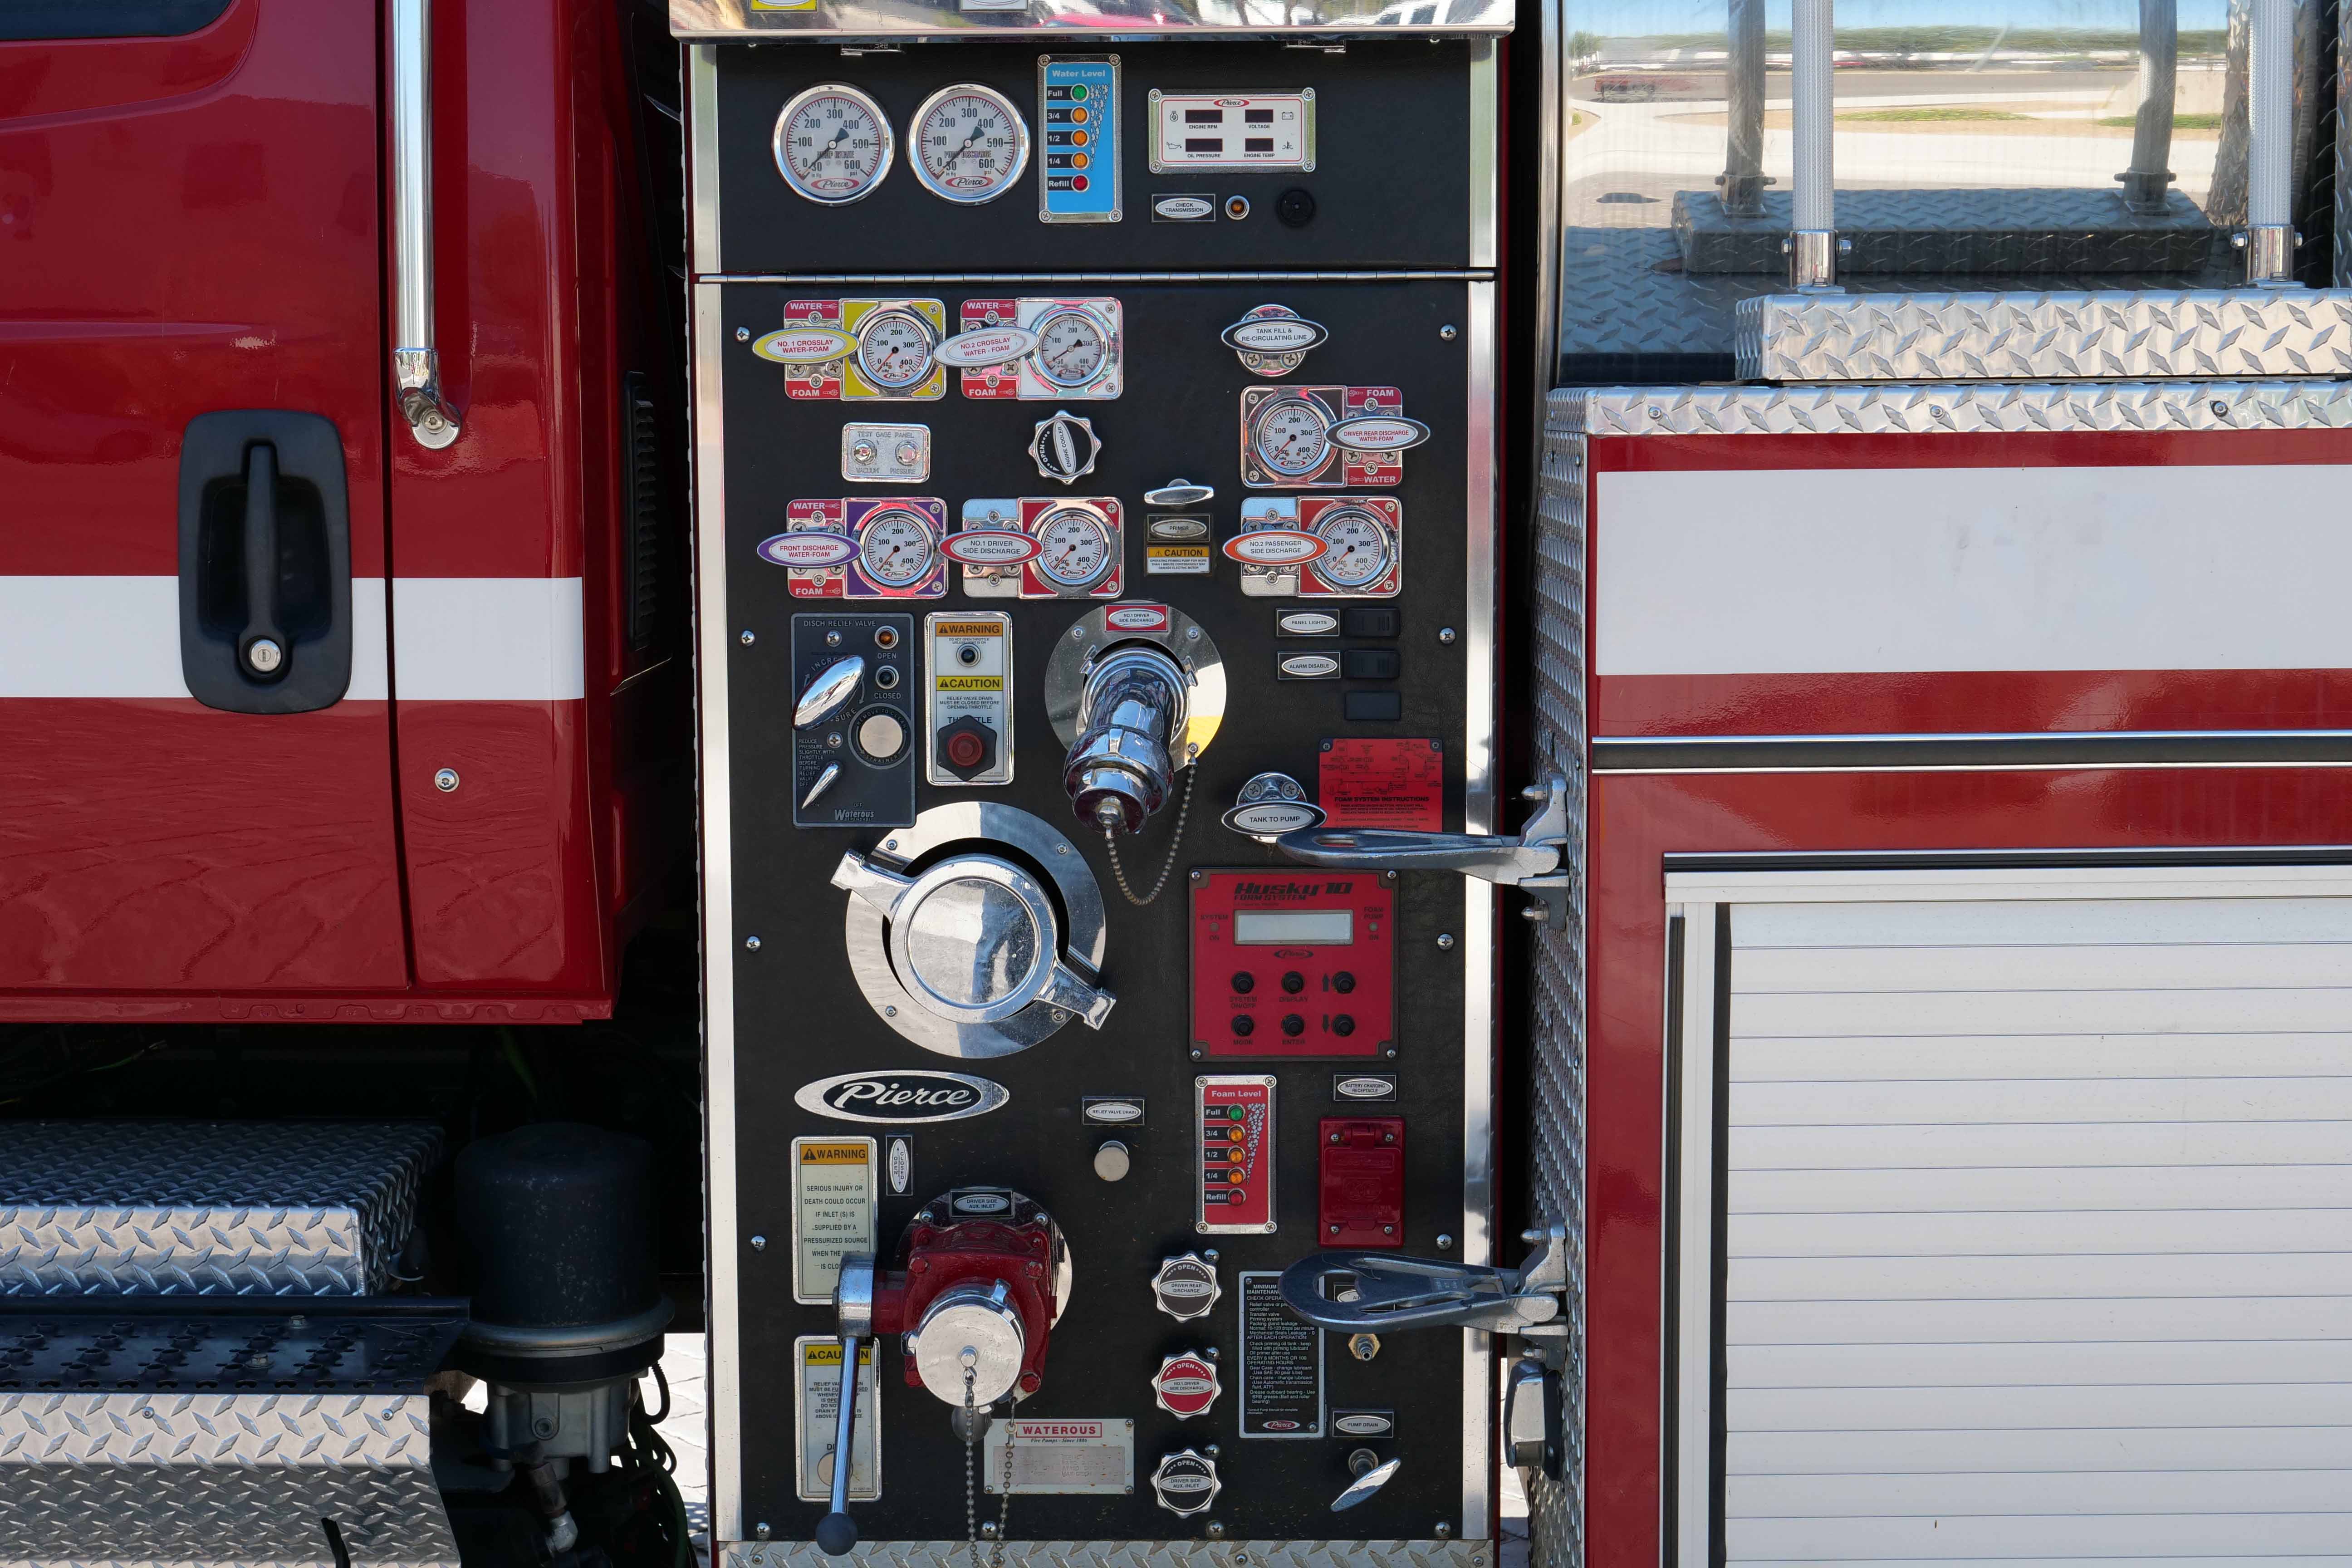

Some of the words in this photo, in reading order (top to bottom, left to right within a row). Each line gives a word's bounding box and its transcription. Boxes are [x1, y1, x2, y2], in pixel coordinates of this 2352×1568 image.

[827, 109, 843, 118] 300
[961, 108, 977, 117] 300
[805, 119, 820, 128] 200
[843, 120, 858, 129] 400
[939, 118, 955, 127] 200
[978, 119, 993, 128] 400
[798, 137, 812, 147] 100
[853, 139, 868, 148] 500
[933, 136, 946, 146] 100
[987, 138, 1003, 147] 500
[844, 160, 860, 169] 600
[979, 159, 995, 168] 600
[977, 337, 1010, 347] CROSSLAY
[1058, 426, 1066, 447] COOLER
[949, 625, 999, 633] WARNING
[950, 679, 999, 688] CAUTION
[834, 809, 874, 820] Waterous
[1235, 883, 1320, 896] Husky
[1325, 882, 1353, 893] 10
[834, 1082, 972, 1108] Pierce
[817, 1150, 865, 1158] WARNING
